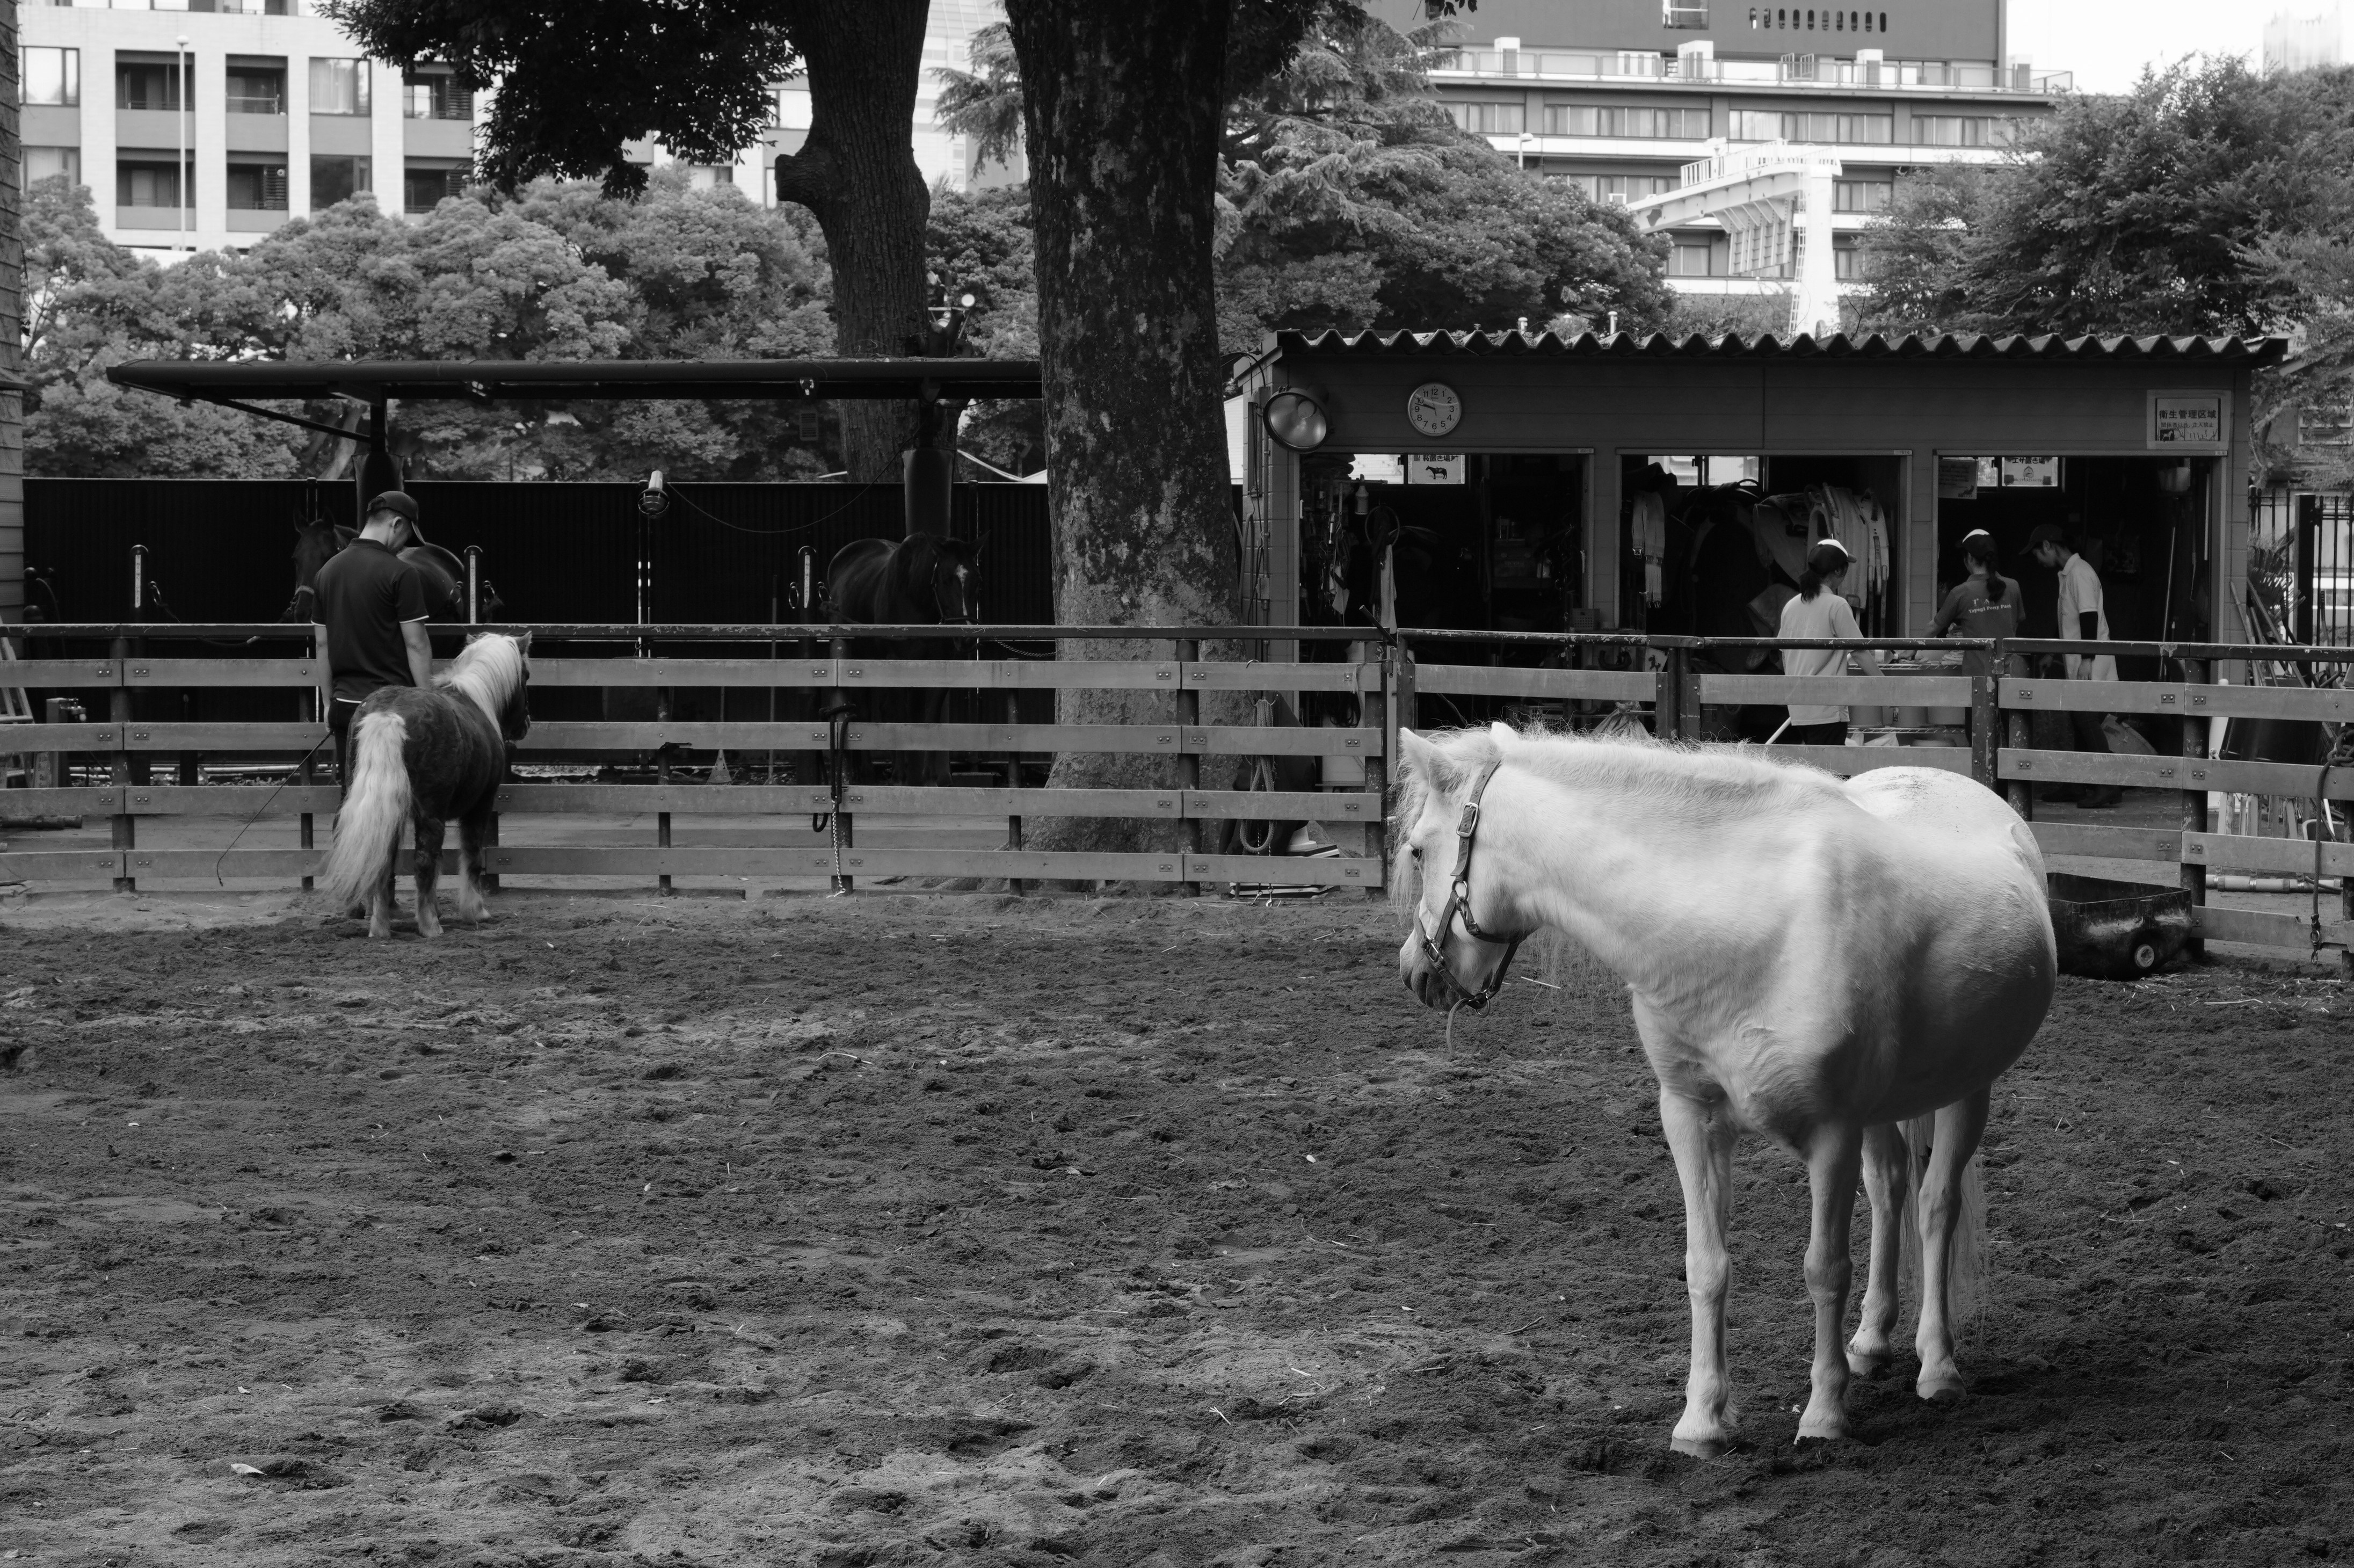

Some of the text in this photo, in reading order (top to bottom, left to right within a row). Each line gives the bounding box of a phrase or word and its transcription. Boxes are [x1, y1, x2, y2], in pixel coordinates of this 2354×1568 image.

[2159, 410, 2216, 419] 衛生管理区域
